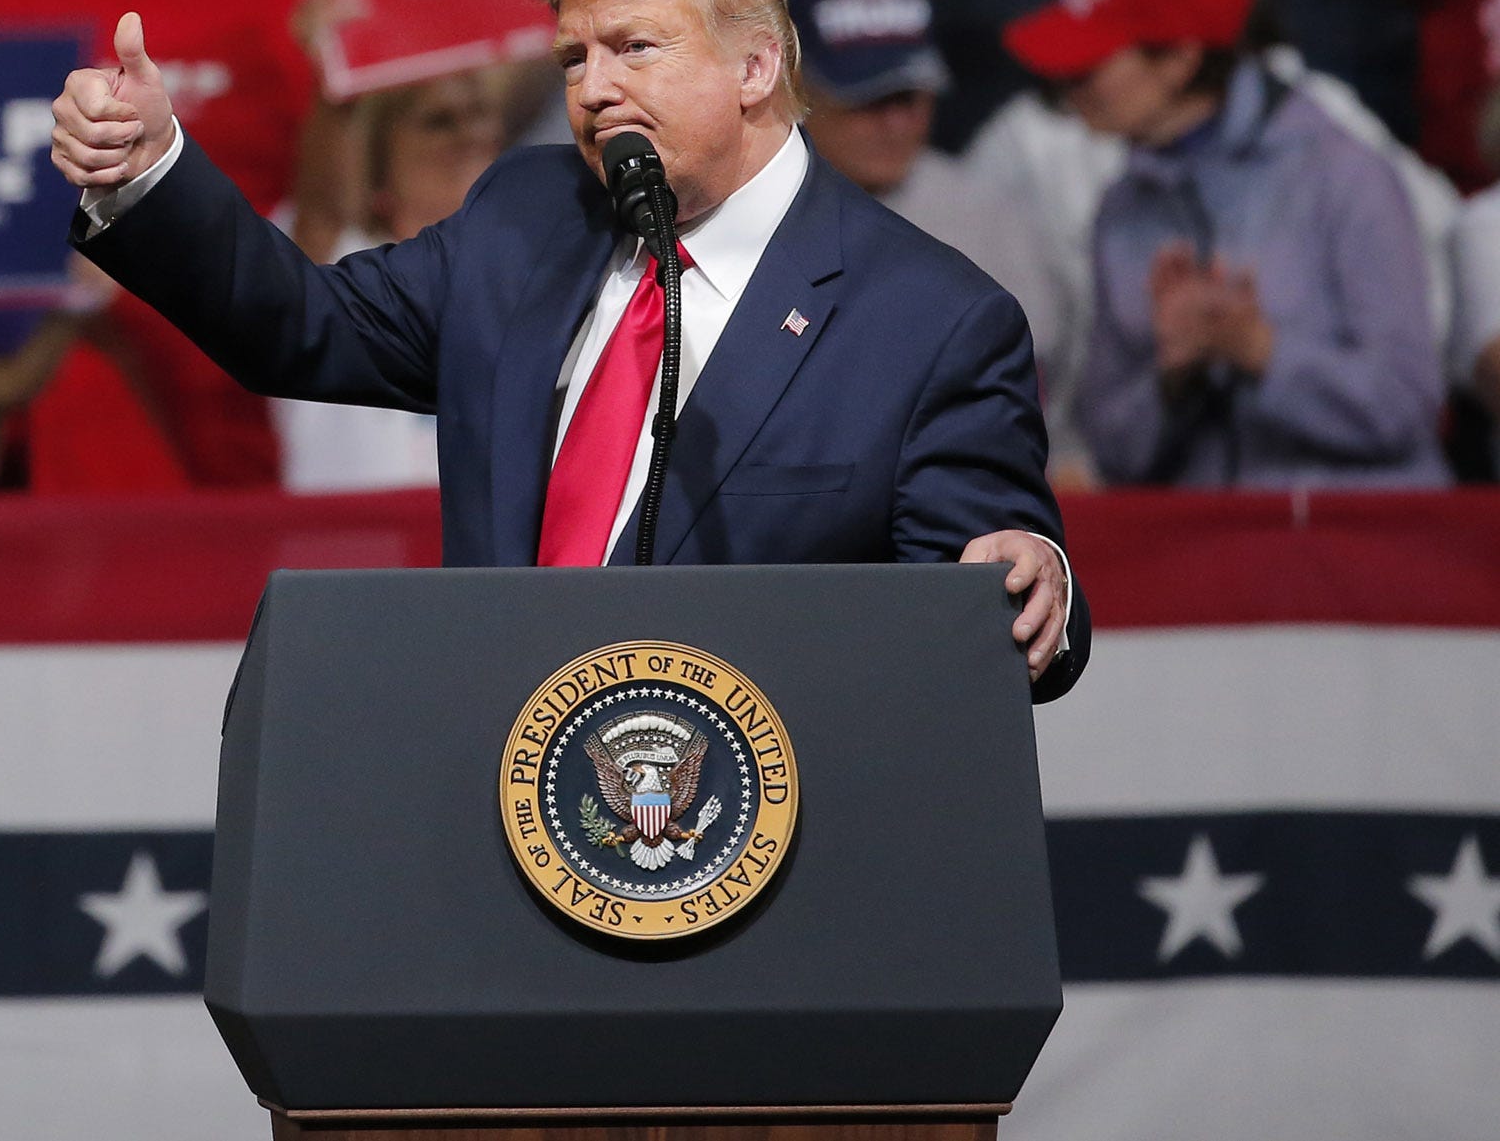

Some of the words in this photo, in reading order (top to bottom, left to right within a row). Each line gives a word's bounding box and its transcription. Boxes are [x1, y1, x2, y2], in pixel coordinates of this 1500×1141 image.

[648, 656, 674, 673] OF
[680, 660, 717, 689] THE
[511, 653, 637, 786] PRESIDENT
[725, 684, 788, 805] UNITED
[515, 798, 538, 839] THE
[527, 843, 551, 868] OF
[680, 832, 777, 924] STATES
[552, 866, 626, 926] SEAL
